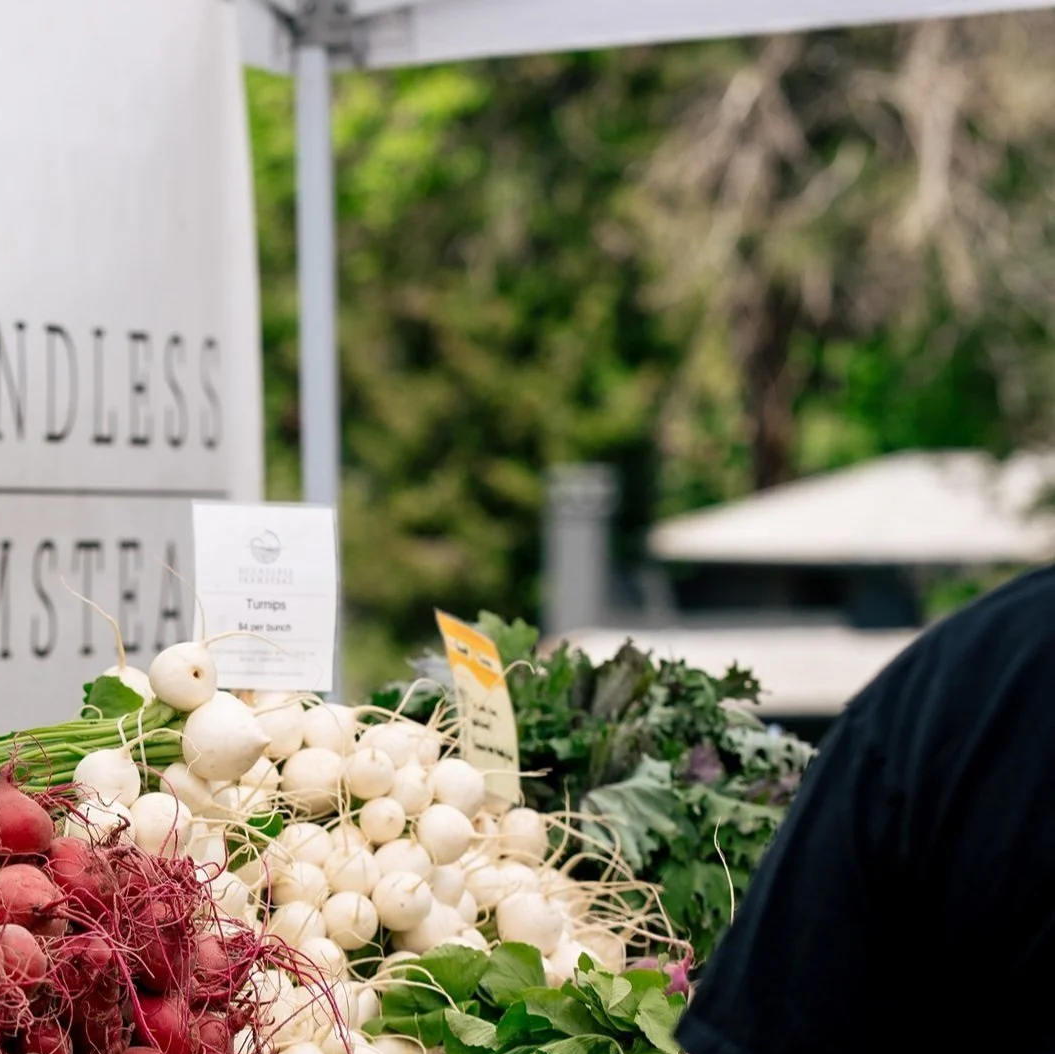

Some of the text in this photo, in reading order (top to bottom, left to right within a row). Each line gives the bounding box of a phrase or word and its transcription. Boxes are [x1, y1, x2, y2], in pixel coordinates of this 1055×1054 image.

[246, 598, 287, 612] Turnips
[250, 623, 264, 632] per
[266, 622, 292, 632] bunch
